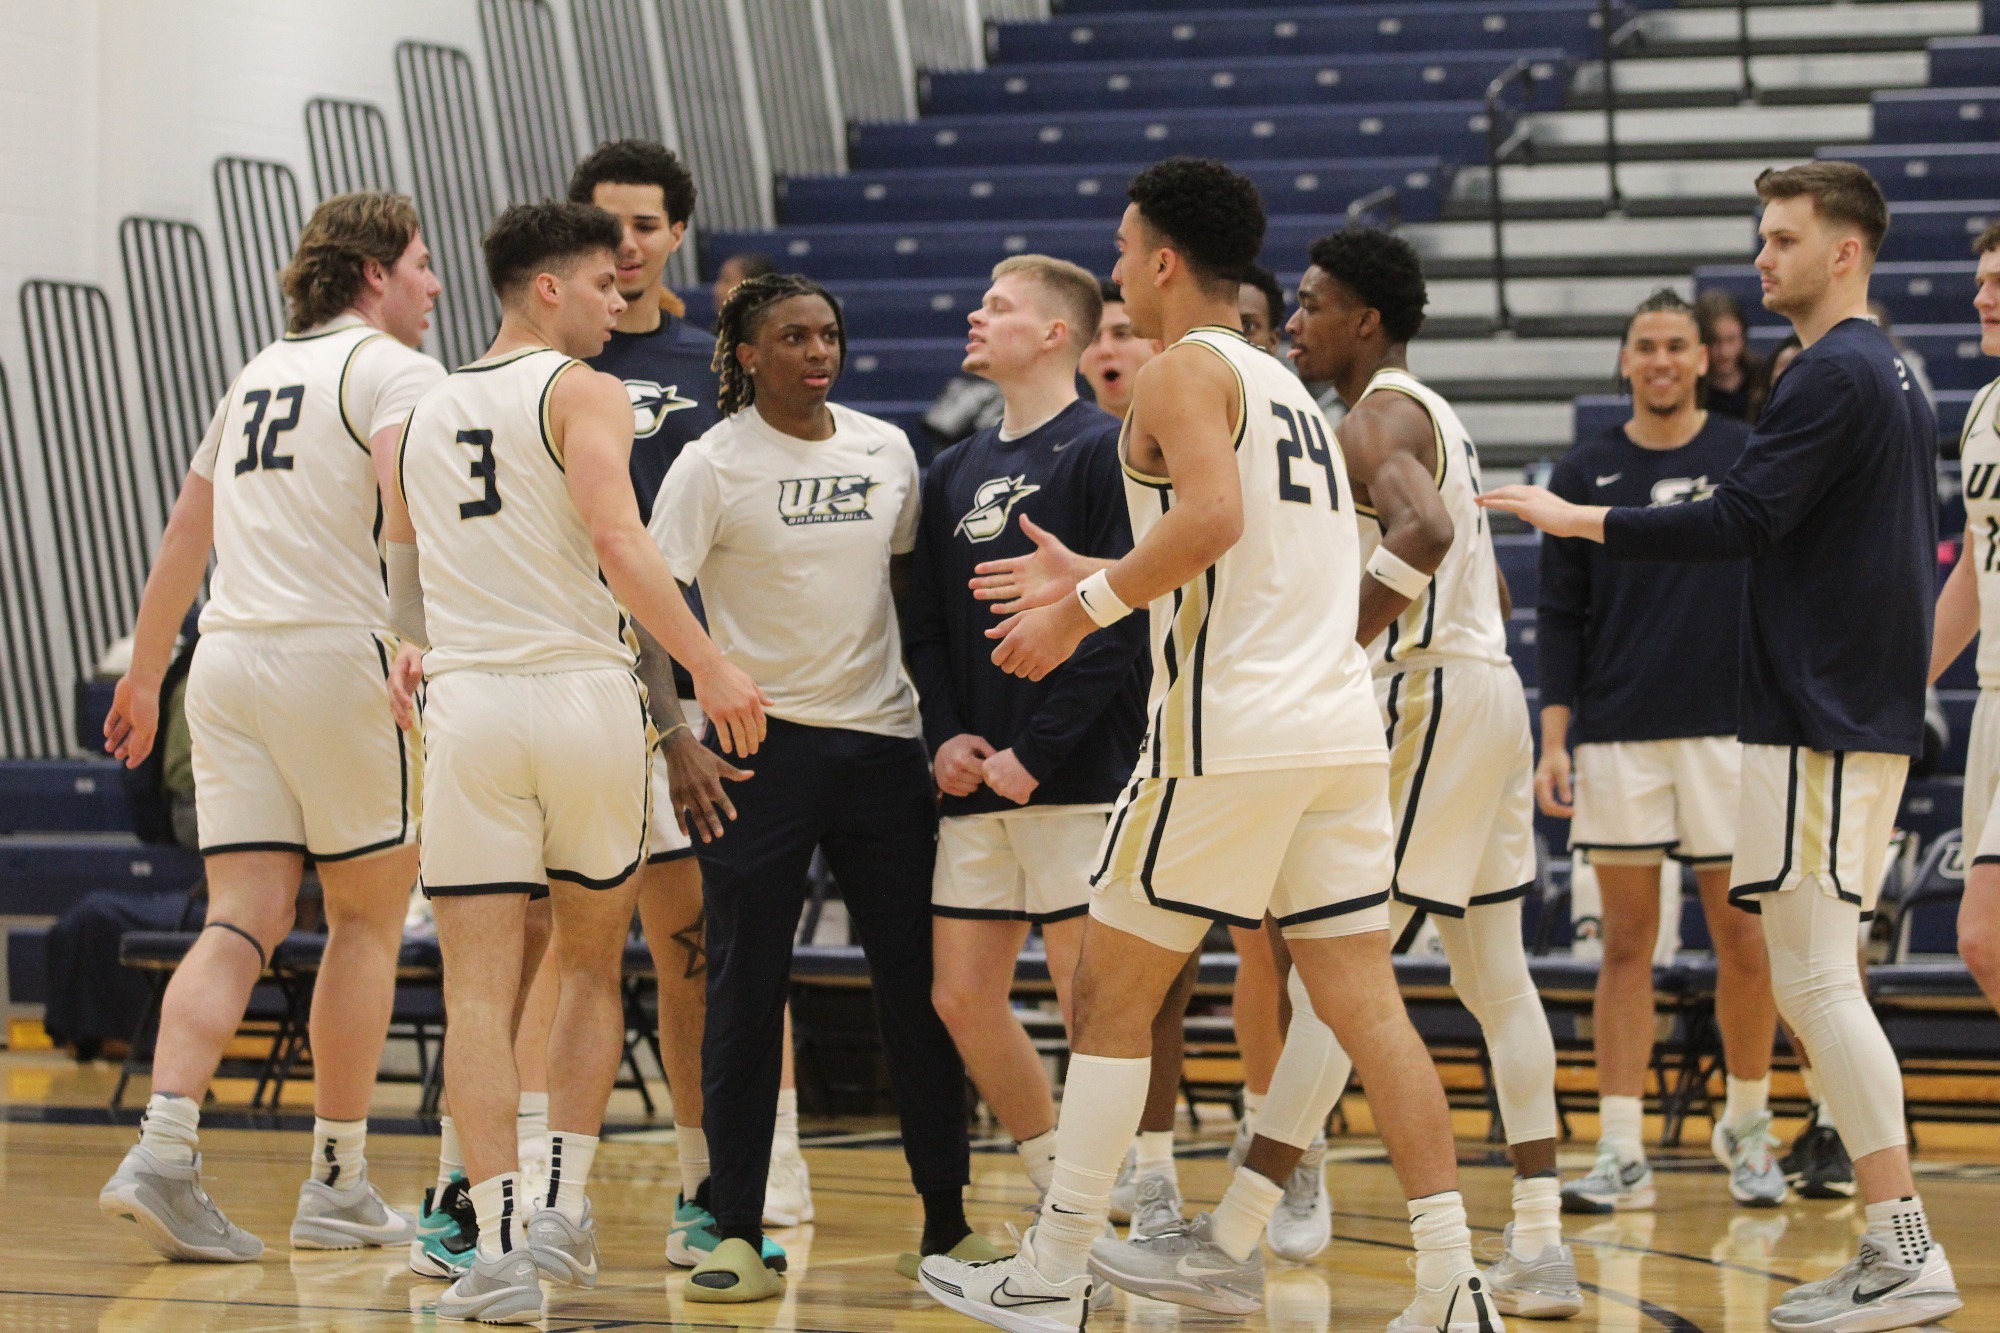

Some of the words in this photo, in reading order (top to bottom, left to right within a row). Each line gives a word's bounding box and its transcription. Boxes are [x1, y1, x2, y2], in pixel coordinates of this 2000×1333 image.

[234, 384, 305, 478] 32
[456, 429, 502, 520] 3
[1270, 400, 1339, 512] 24
[778, 474, 882, 517] UIS
[787, 511, 868, 525] BASKETBALL
